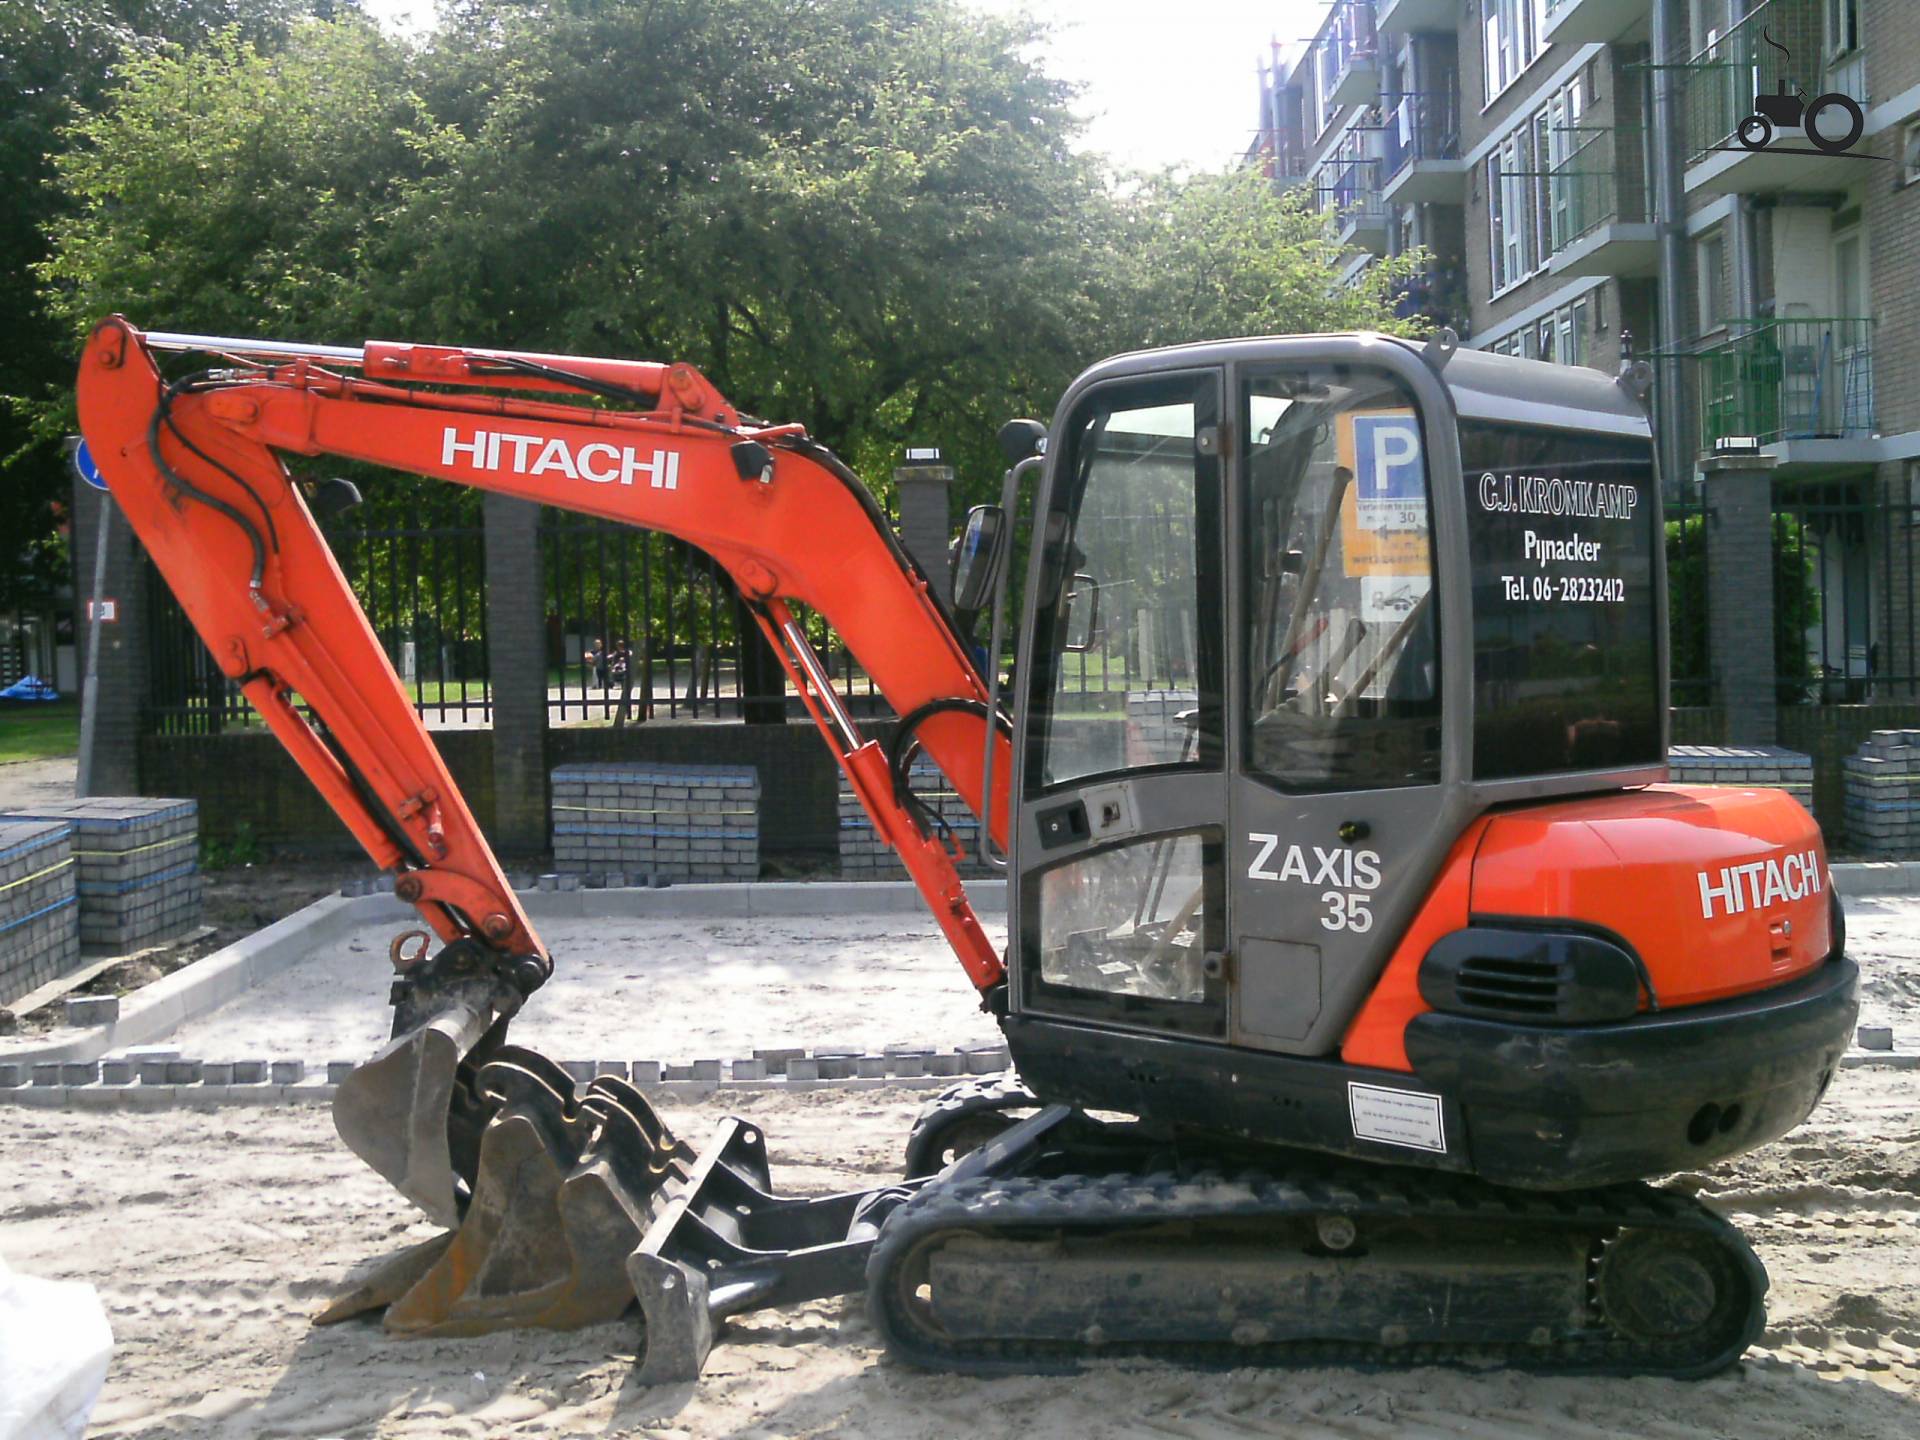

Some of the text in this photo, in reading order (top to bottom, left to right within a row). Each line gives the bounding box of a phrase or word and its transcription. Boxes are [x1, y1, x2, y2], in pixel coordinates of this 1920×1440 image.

[441, 427, 680, 490] HITACHI
[1373, 427, 1419, 490] P
[1399, 511, 1416, 524] 30
[1519, 476, 1638, 520] KROMKAMP
[1524, 530, 1601, 568] Pijnacker
[1501, 575, 1625, 602] Tel. 06-28232412
[1248, 832, 1382, 890] ZAXIS
[1697, 850, 1821, 919] HITACHI
[1320, 890, 1373, 933] 35
